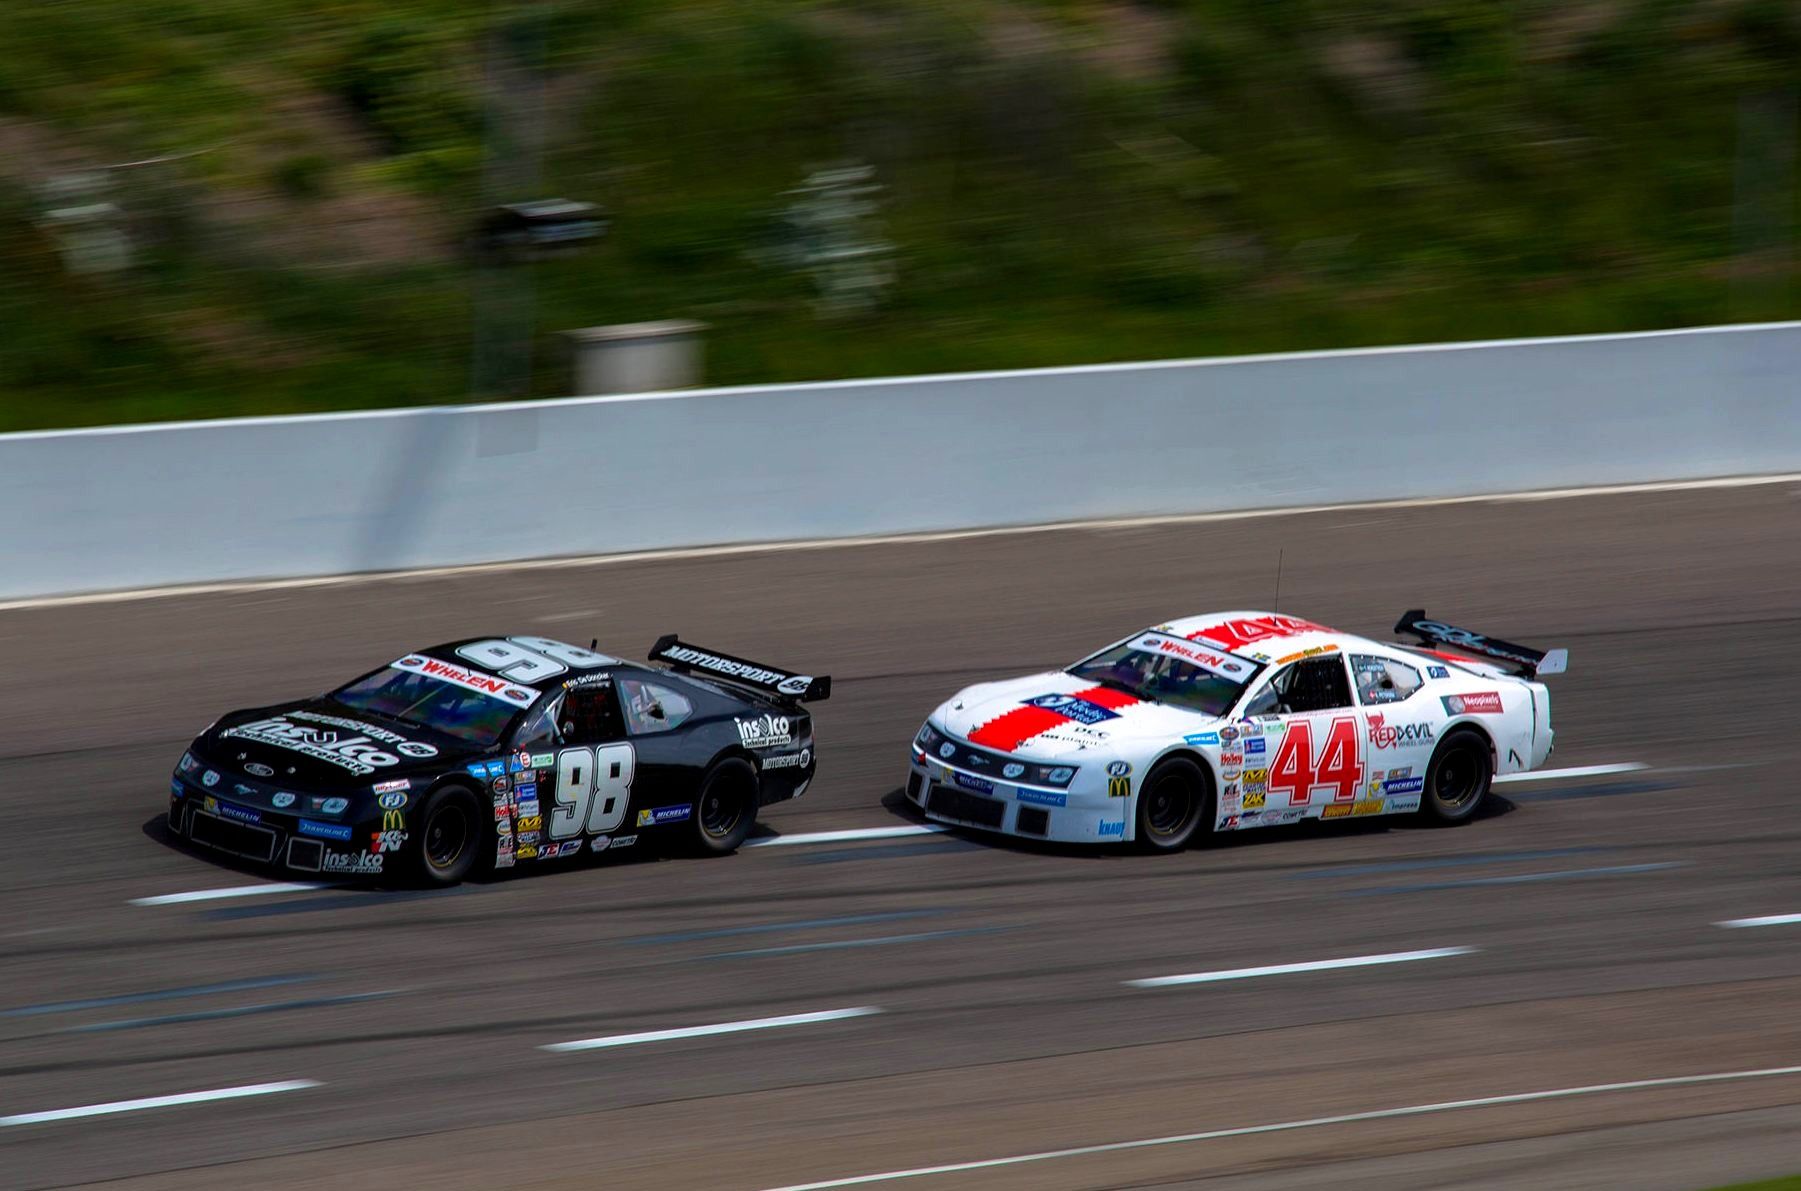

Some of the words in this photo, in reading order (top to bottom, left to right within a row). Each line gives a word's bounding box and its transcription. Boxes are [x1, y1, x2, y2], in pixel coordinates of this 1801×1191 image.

[661, 645, 786, 685] MOTORSPORT
[1160, 640, 1224, 667] WHELEN
[420, 657, 505, 693] WHELEN
[1266, 716, 1365, 806] 44
[549, 741, 636, 841] 98
[1387, 780, 1422, 791] MICHELIN
[222, 806, 260, 823] MICHELIN
[655, 808, 691, 819] MICHELIN
